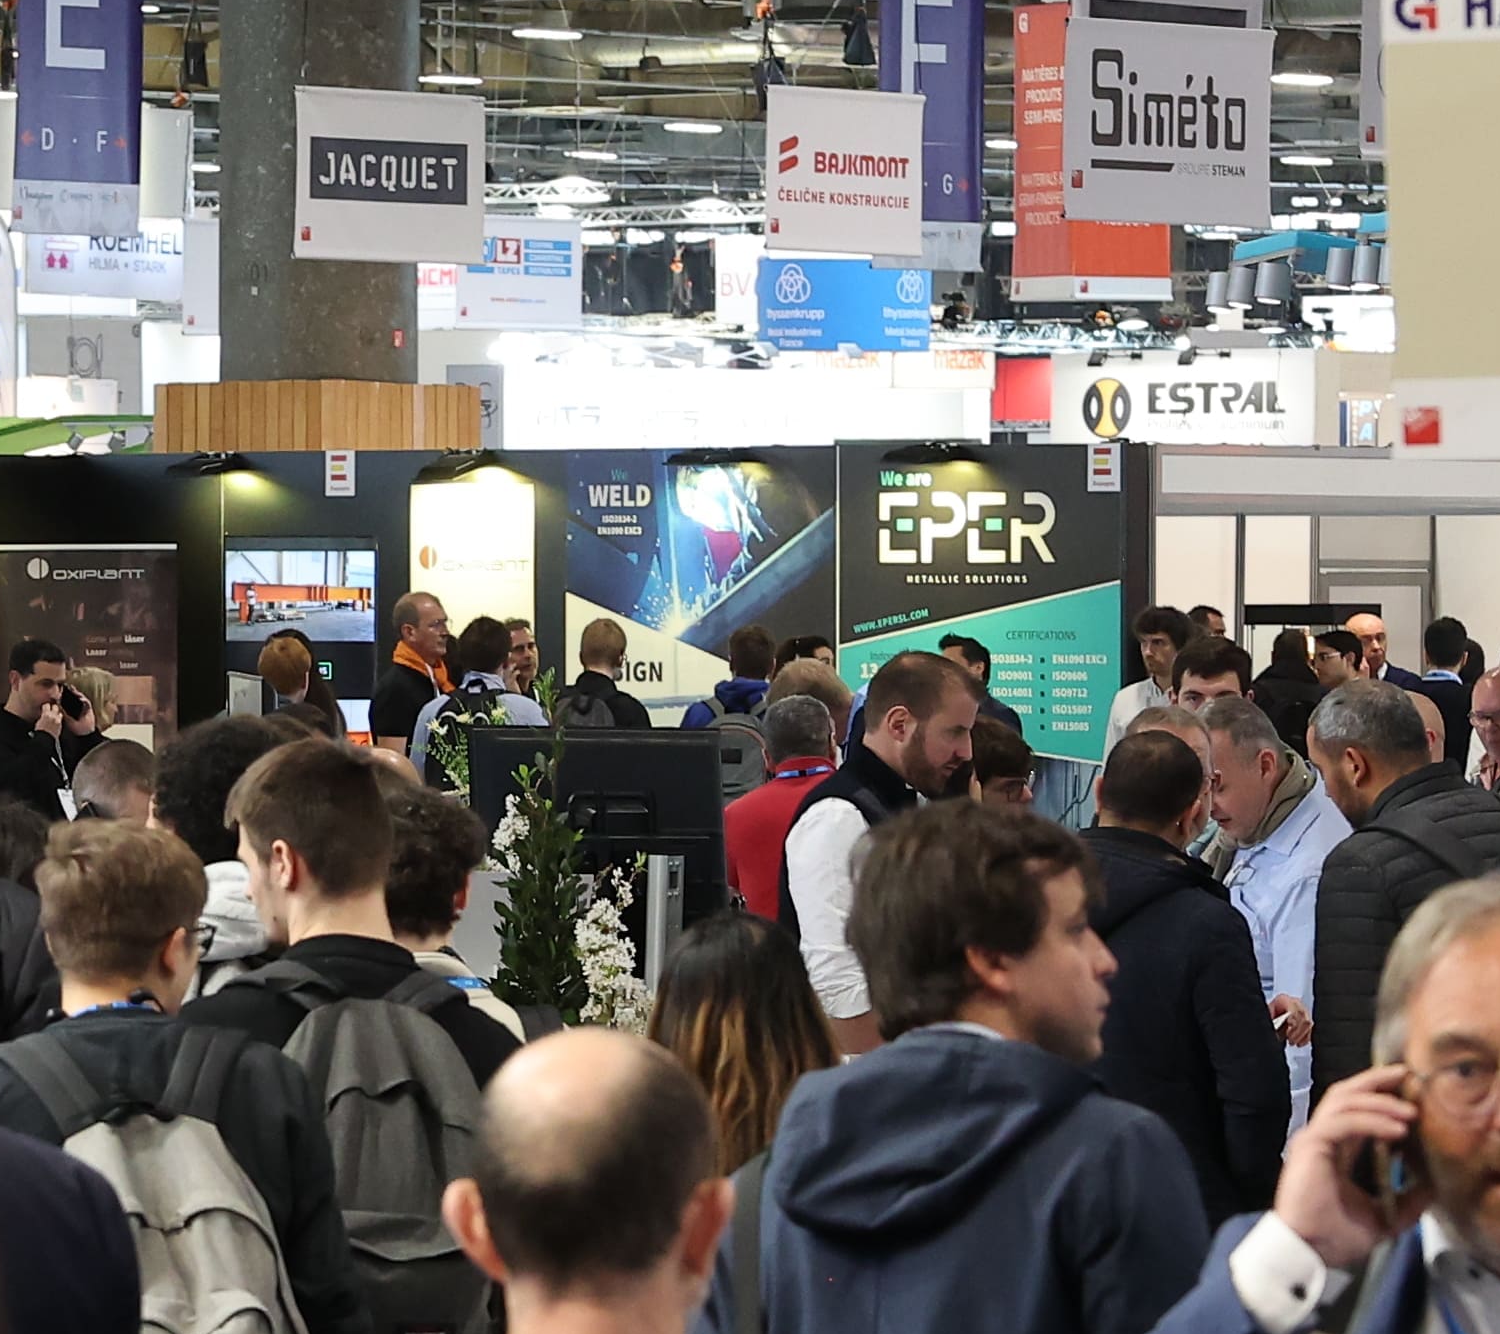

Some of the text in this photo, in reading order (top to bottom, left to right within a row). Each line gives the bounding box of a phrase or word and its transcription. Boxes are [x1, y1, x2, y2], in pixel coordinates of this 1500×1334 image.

[1091, 48, 1246, 150] Siméto
[41, 128, 107, 153] D F
[319, 152, 457, 191] JACQUET
[814, 150, 909, 179] BAJKMONT
[1212, 164, 1245, 178] STEMAN
[942, 174, 953, 194] G
[829, 191, 910, 209] KONSTRUKCIJE
[880, 471, 932, 486] We are
[589, 484, 651, 507] WELD
[879, 491, 1056, 564] EPER
[906, 575, 1028, 585] METALLIC SOLUTIONS
[1006, 630, 1076, 641] CERTIFICATIONS
